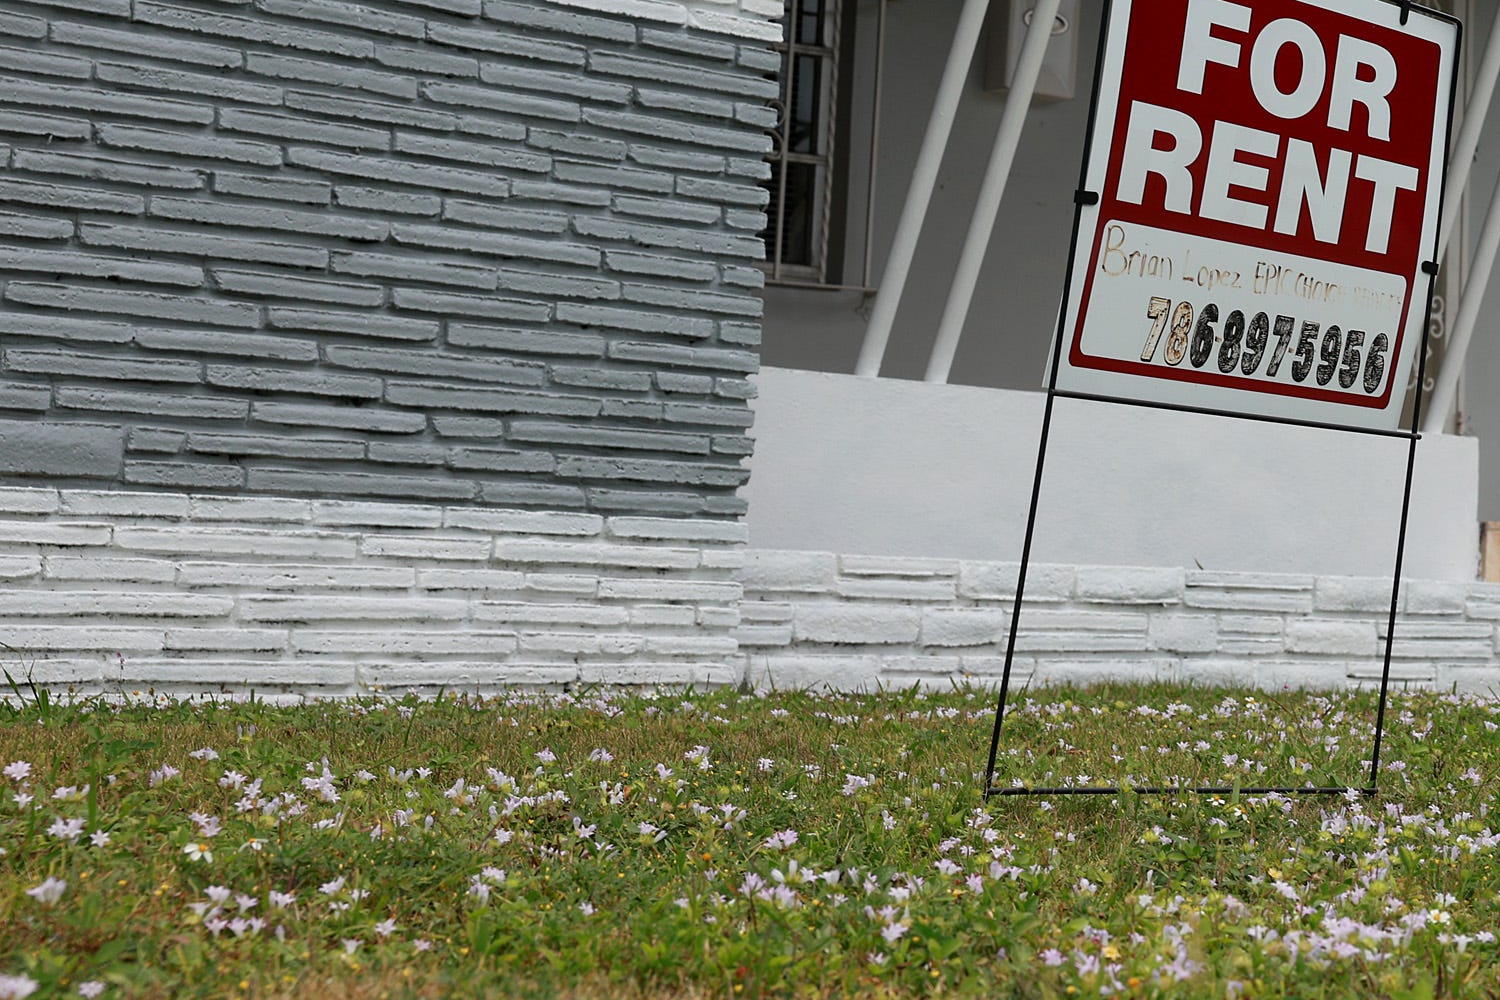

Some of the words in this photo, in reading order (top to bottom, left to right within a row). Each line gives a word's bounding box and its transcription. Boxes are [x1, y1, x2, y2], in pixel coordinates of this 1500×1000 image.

[1116, 99, 1419, 255] RENT
[1101, 224, 1174, 281] Brian
[1182, 249, 1242, 290] Lopez
[1140, 295, 1389, 394] 786-897-5956
